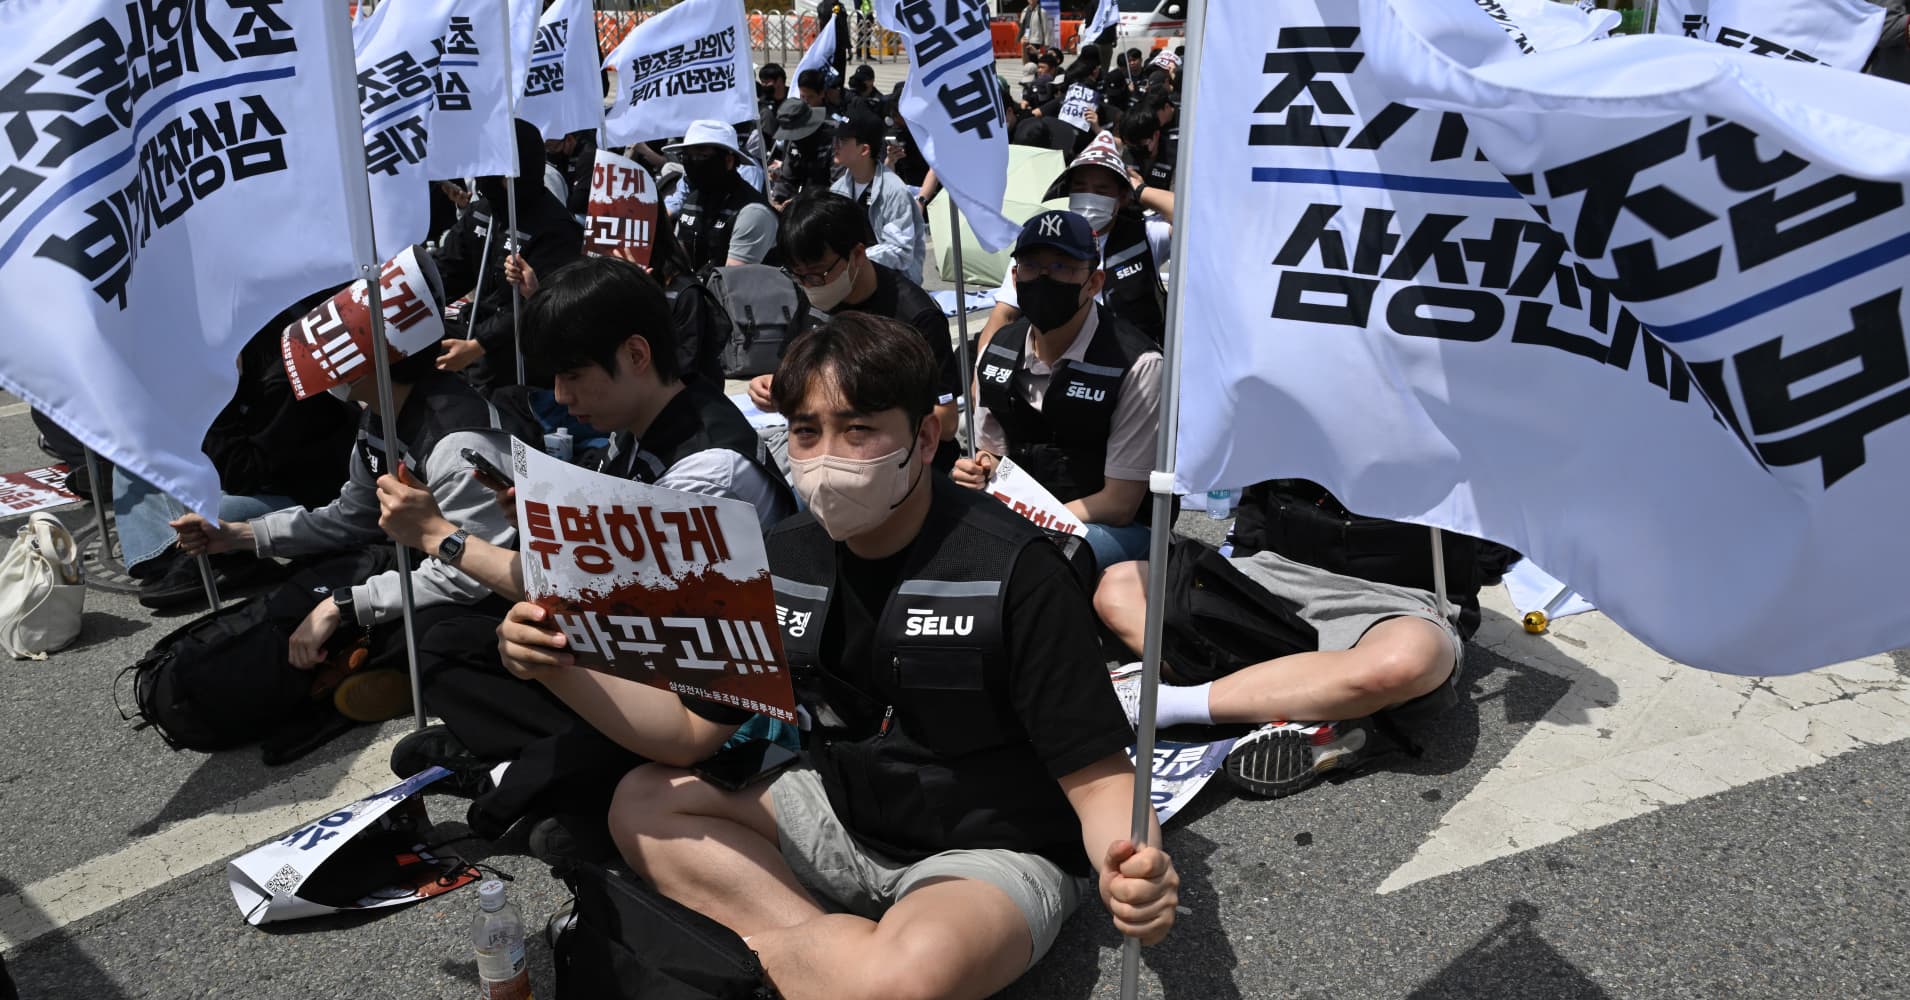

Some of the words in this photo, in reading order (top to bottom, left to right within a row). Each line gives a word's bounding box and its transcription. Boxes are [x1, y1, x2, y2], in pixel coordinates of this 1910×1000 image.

[1038, 214, 1063, 237] NY
[1116, 261, 1143, 280] SELU
[982, 363, 1013, 383] 투쟁
[1066, 384, 1106, 402] SELU
[525, 500, 732, 576] 투명하게
[905, 610, 975, 636] SELU
[552, 611, 778, 675] 바꾸고!!!
[669, 681, 740, 707] 삼성전자노동조합
[740, 697, 794, 721] 공동투쟁본부
